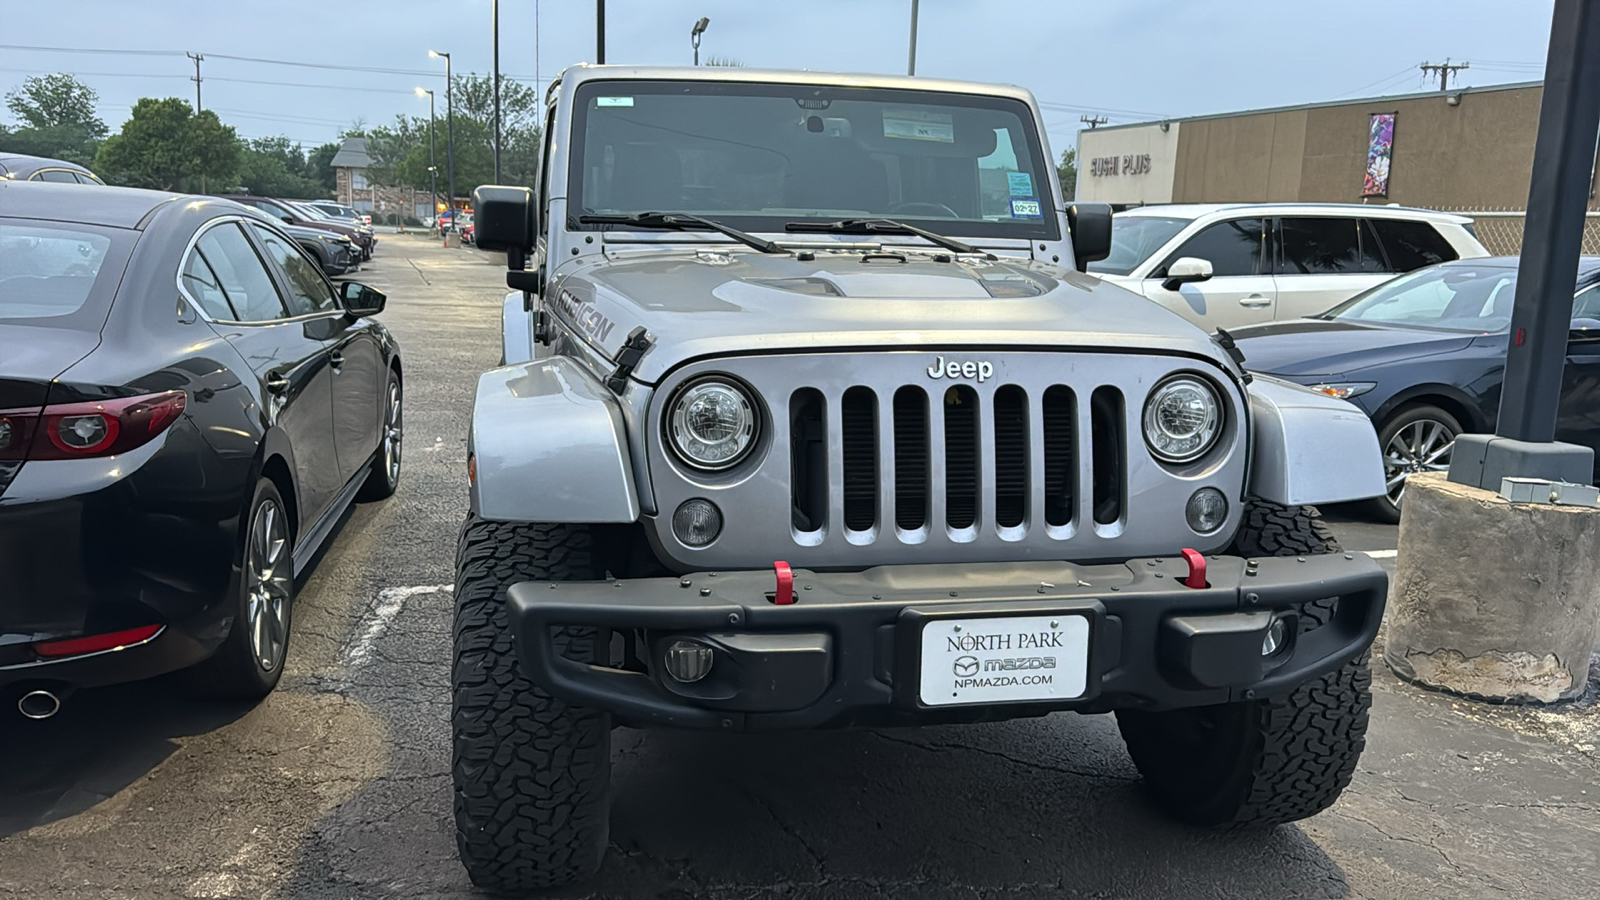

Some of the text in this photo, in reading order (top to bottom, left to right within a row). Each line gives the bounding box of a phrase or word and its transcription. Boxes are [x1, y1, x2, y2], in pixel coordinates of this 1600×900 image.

[1090, 154, 1152, 177] SUSHI PLUS
[926, 355, 994, 383] Jeep
[946, 631, 1064, 653] NORTH PARK
[954, 675, 1053, 689] NPMAZDA.COM
